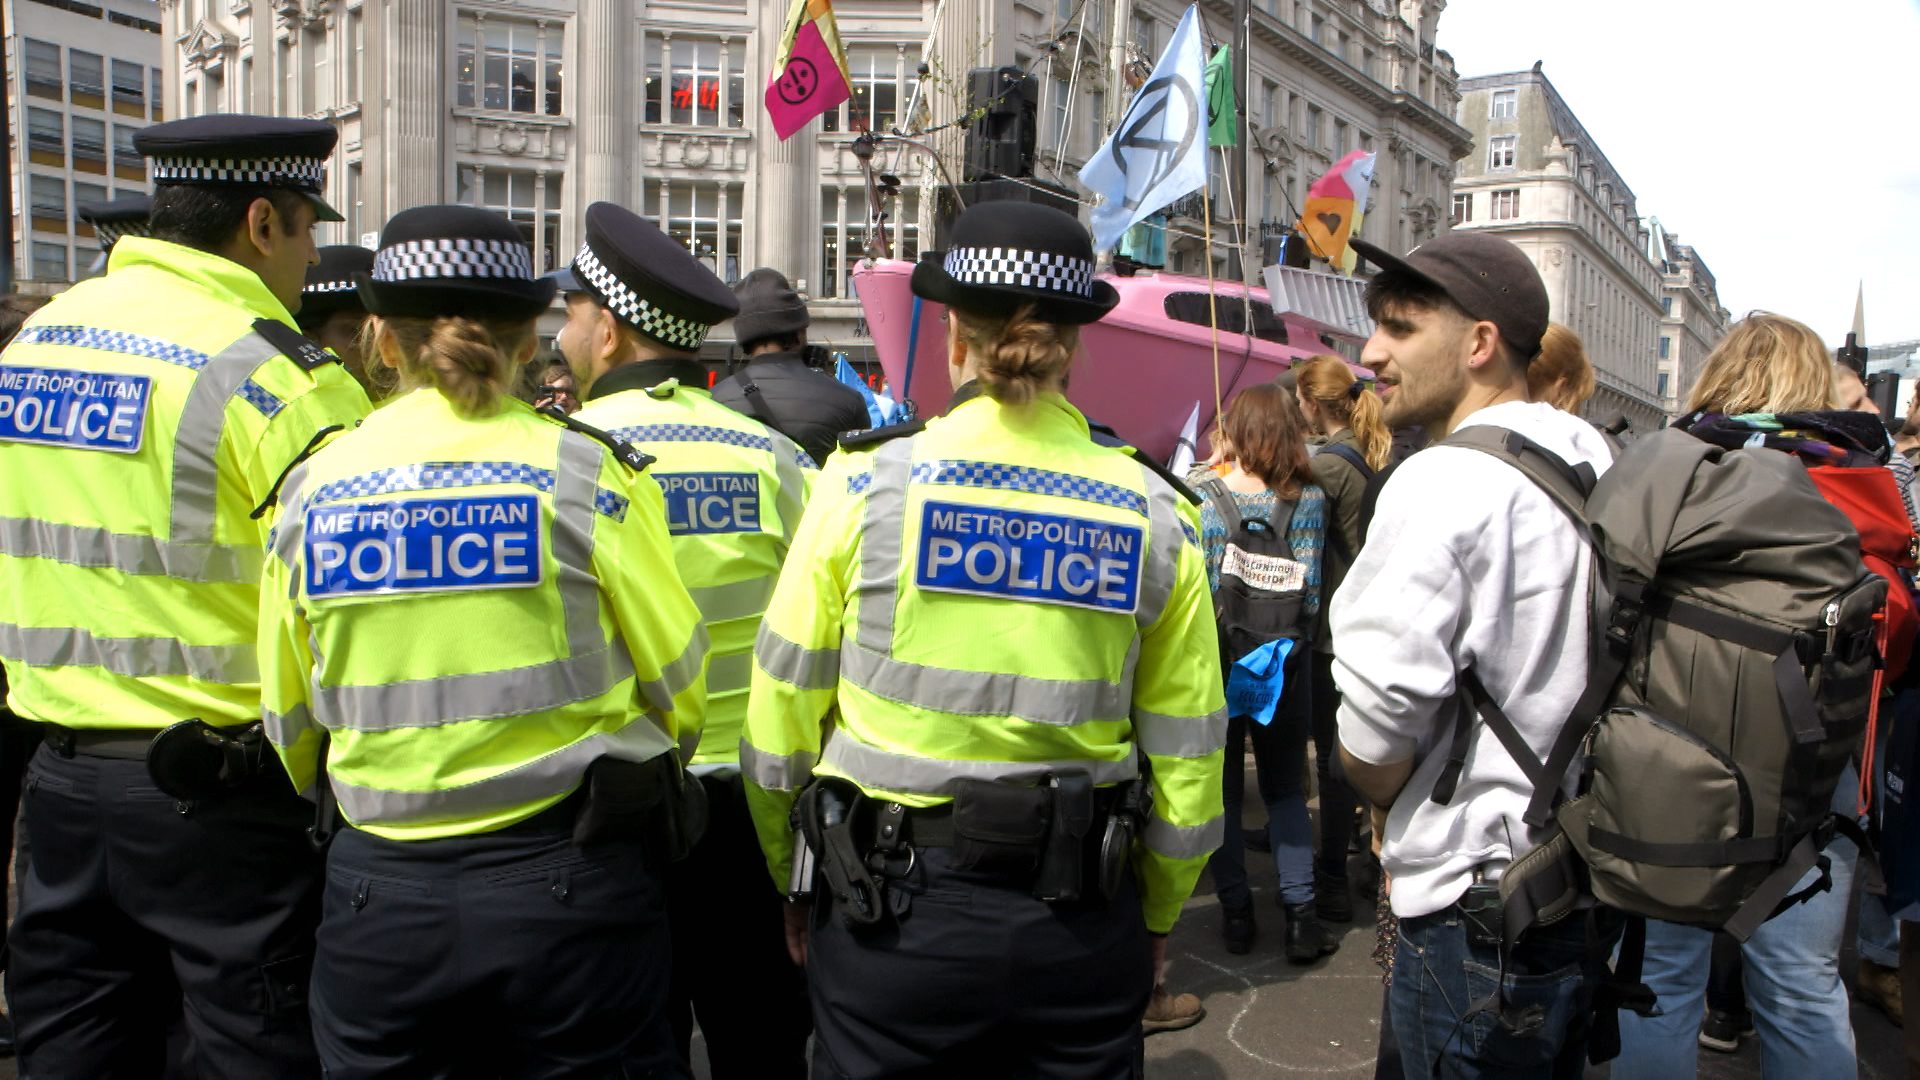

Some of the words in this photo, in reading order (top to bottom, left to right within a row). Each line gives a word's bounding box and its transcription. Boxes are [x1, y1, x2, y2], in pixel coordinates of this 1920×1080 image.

[0, 373, 143, 400] METROPOLITAN
[313, 503, 528, 535] METROPOLITAN
[931, 509, 1133, 554] METROPOLITAN
[313, 532, 529, 586] POLICE
[927, 536, 1129, 601] POLICE
